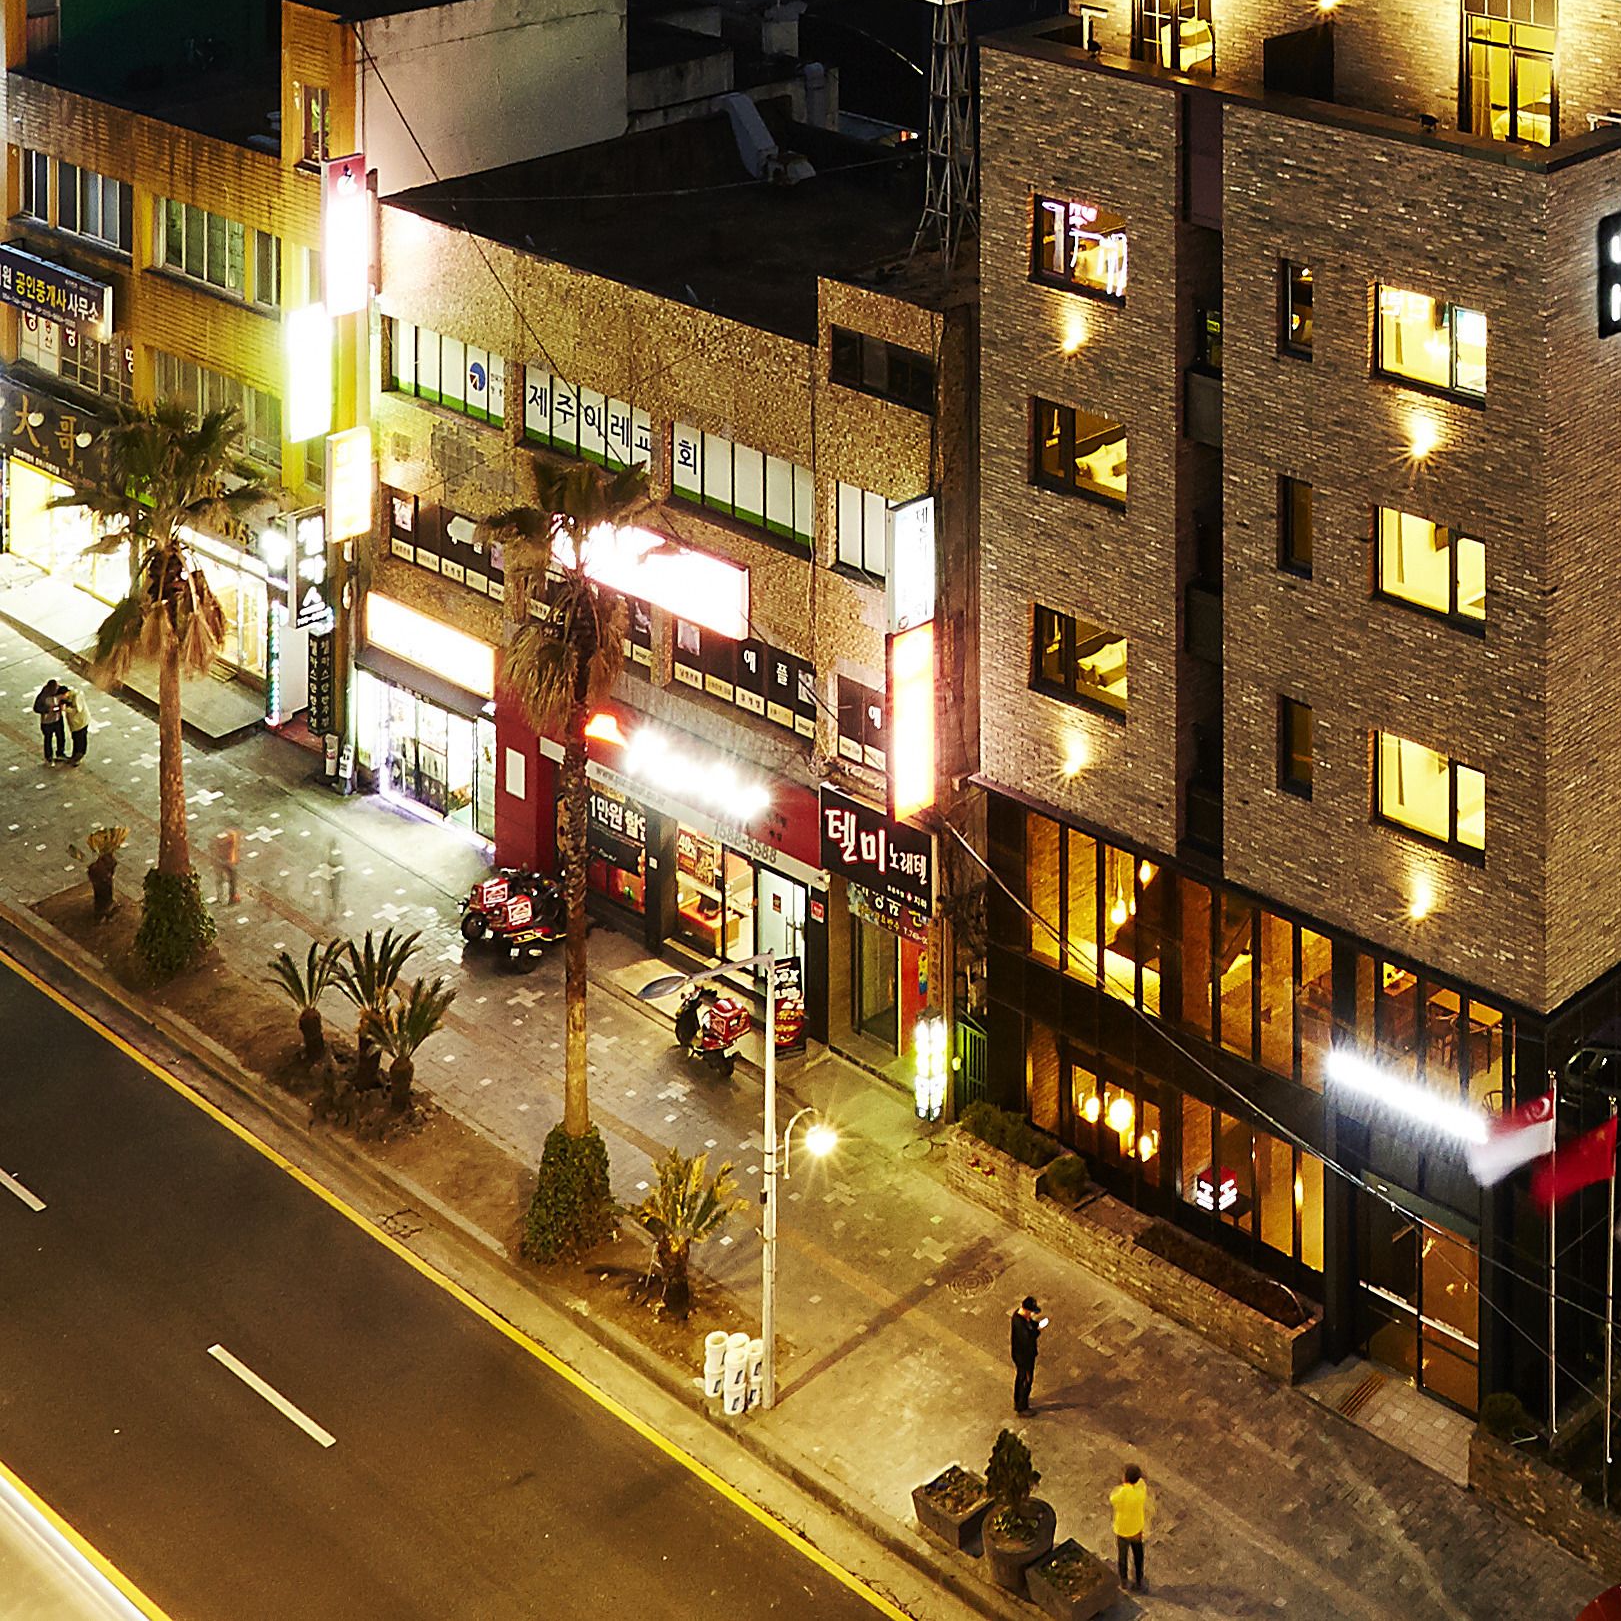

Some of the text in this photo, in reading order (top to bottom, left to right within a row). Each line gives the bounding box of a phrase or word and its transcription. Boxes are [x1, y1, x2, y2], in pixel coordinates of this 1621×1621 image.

[15, 271, 67, 312] 공인중개사
[67, 293, 99, 324] 사무소
[589, 794, 623, 832] 1만원
[714, 822, 778, 864] 1588-5588
[825, 809, 886, 873] 텔미
[889, 842, 928, 885] 노래텔
